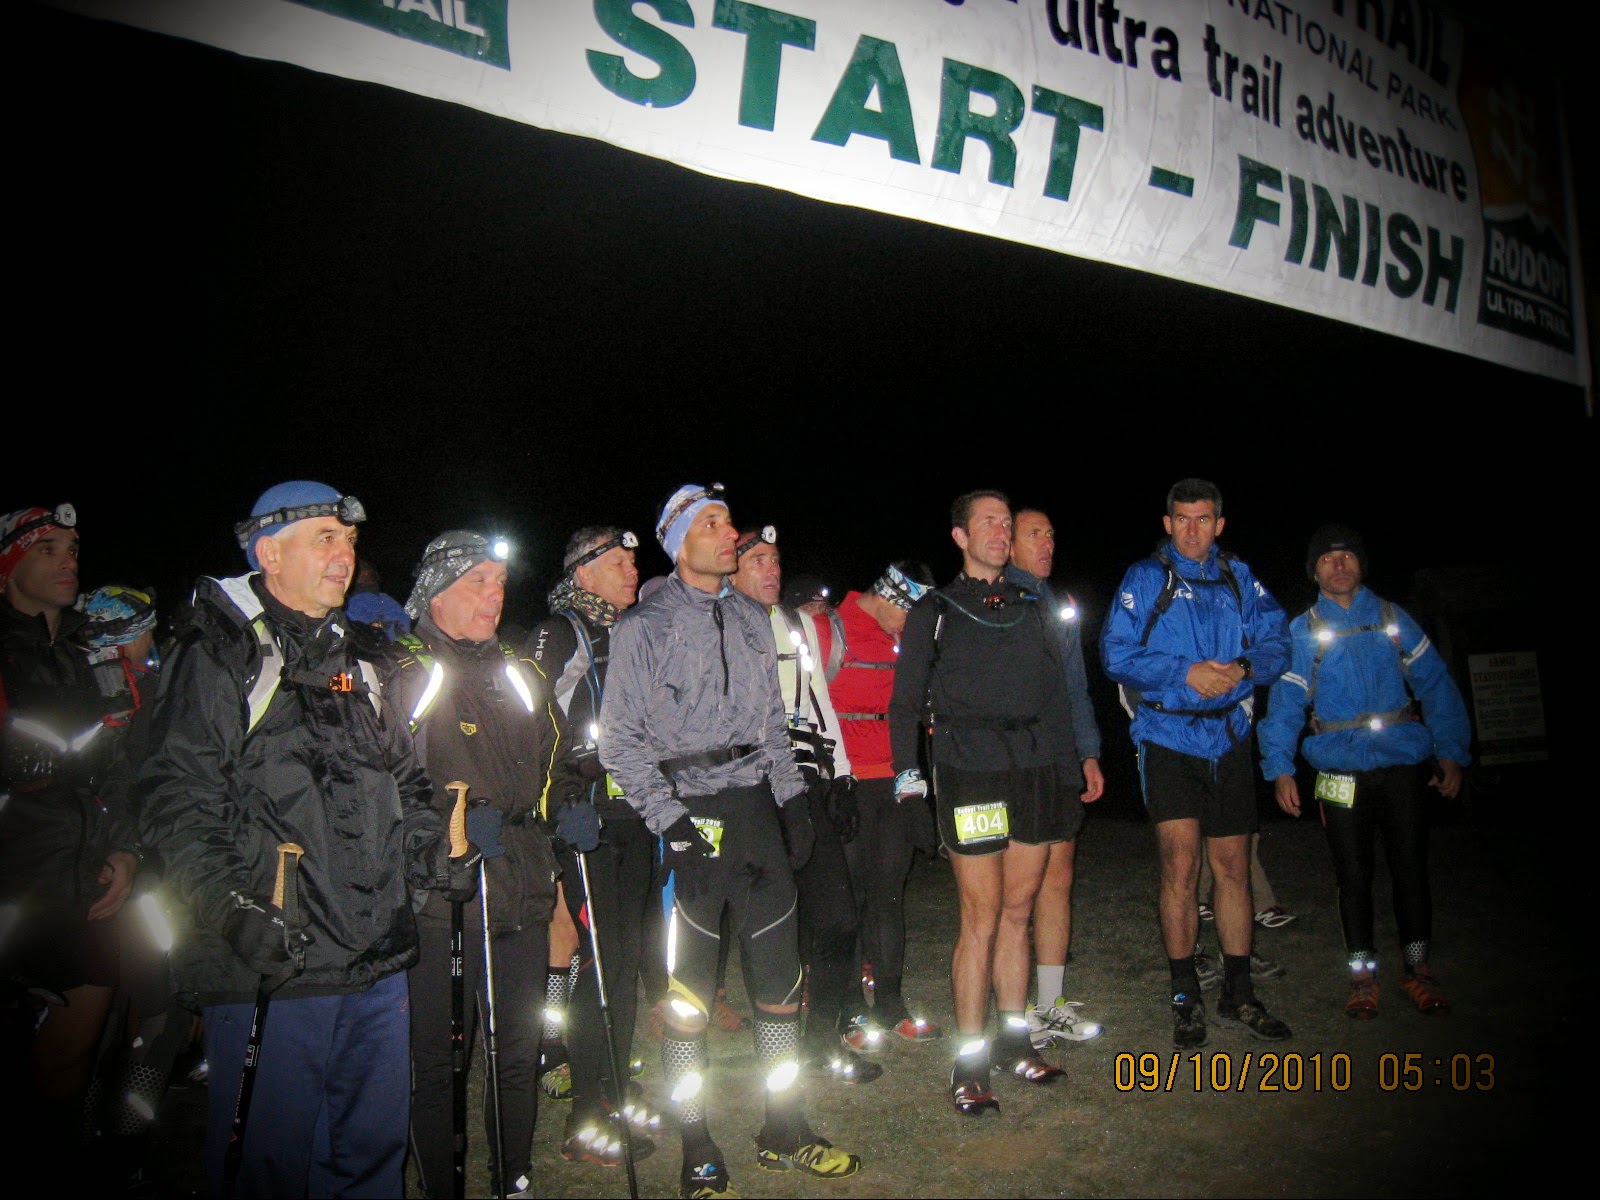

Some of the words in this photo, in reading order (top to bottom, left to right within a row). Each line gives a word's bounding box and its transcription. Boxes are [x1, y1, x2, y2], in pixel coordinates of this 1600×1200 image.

[1046, 0, 1182, 82] ultra
[1202, 24, 1283, 127] trail
[1296, 92, 1468, 204] adventure
[1387, 71, 1457, 131] PARK
[585, 0, 1103, 202] START
[1228, 153, 1464, 314] FINISH
[1488, 227, 1569, 306] RODOPI
[1486, 288, 1537, 325] ULTRA
[1318, 779, 1350, 801] 435
[962, 811, 1004, 834] 404
